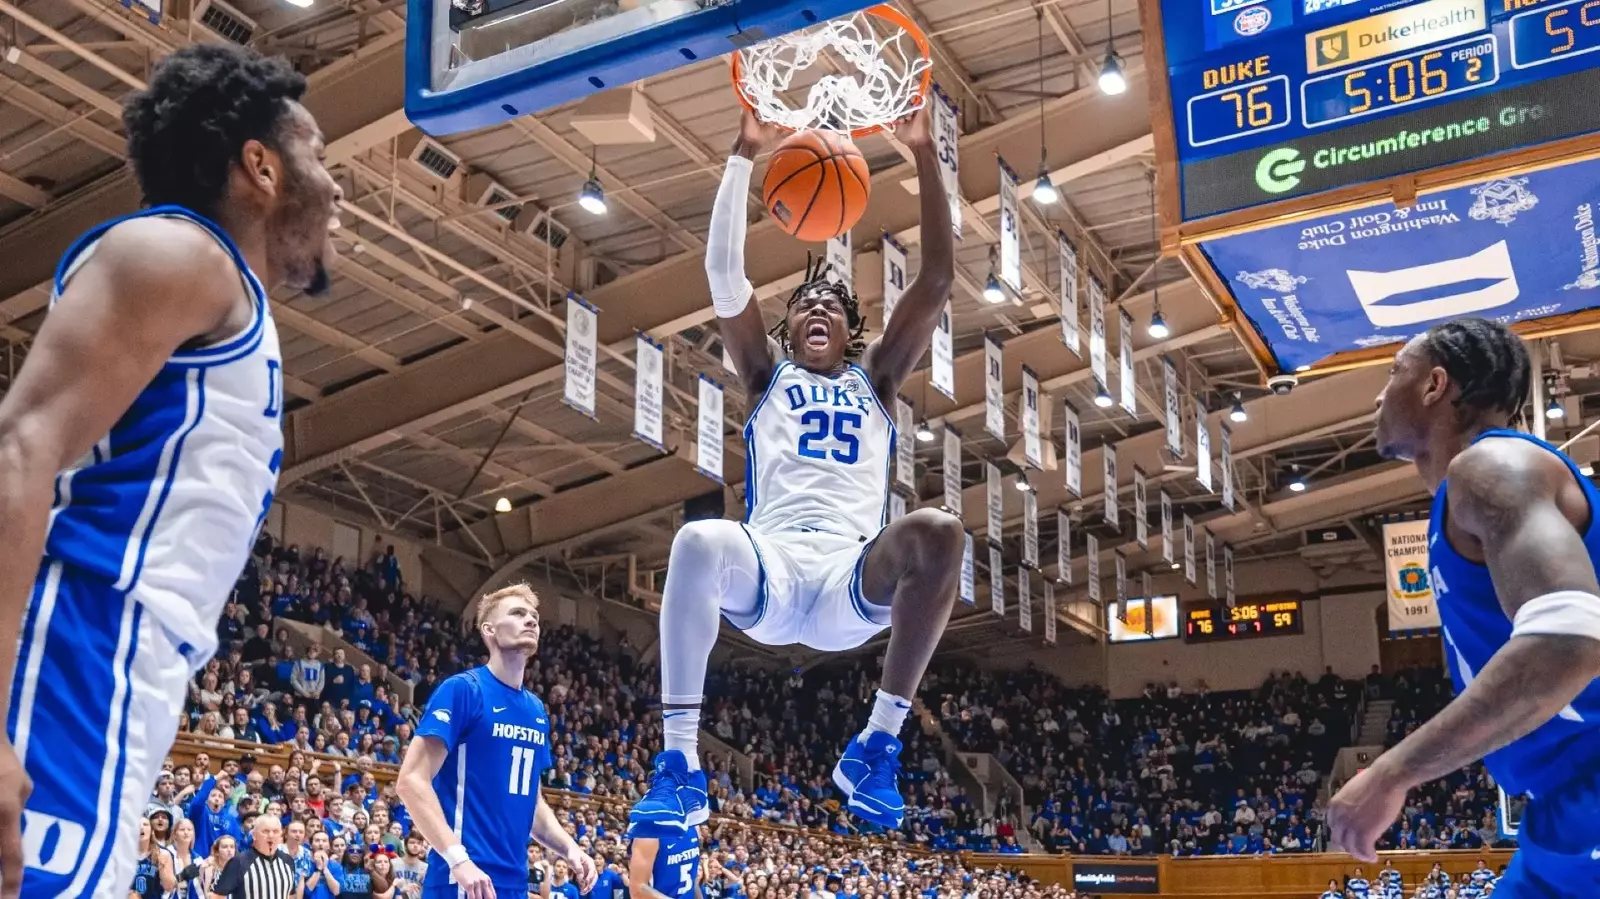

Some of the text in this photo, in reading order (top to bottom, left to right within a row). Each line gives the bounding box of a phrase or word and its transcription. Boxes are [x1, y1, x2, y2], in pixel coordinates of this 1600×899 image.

[1359, 7, 1475, 48] DukeHealth
[1451, 43, 1492, 62] PERIOD
[1203, 55, 1271, 90] DUKE
[1466, 57, 1482, 82] 2
[1345, 51, 1448, 114] 5:06
[1220, 86, 1273, 129] 76
[1313, 116, 1490, 169] Circumference
[1416, 199, 1449, 214] Inn
[1573, 203, 1594, 231] Duke
[1297, 212, 1461, 251] Washington Duke
[1349, 211, 1391, 229] Golf
[785, 383, 872, 416] DUKE
[798, 410, 862, 465] 25
[1388, 545, 1429, 558] CHAMPIO
[1391, 534, 1427, 546] NATIONA
[1230, 605, 1258, 621] 5:06
[1274, 613, 1291, 627] 59
[1405, 605, 1428, 616] 1991
[1196, 620, 1213, 634] 76
[492, 722, 545, 746] HOFSTRA
[508, 746, 535, 796] 11
[667, 846, 700, 866] HOFSTRA
[677, 863, 693, 895] 5
